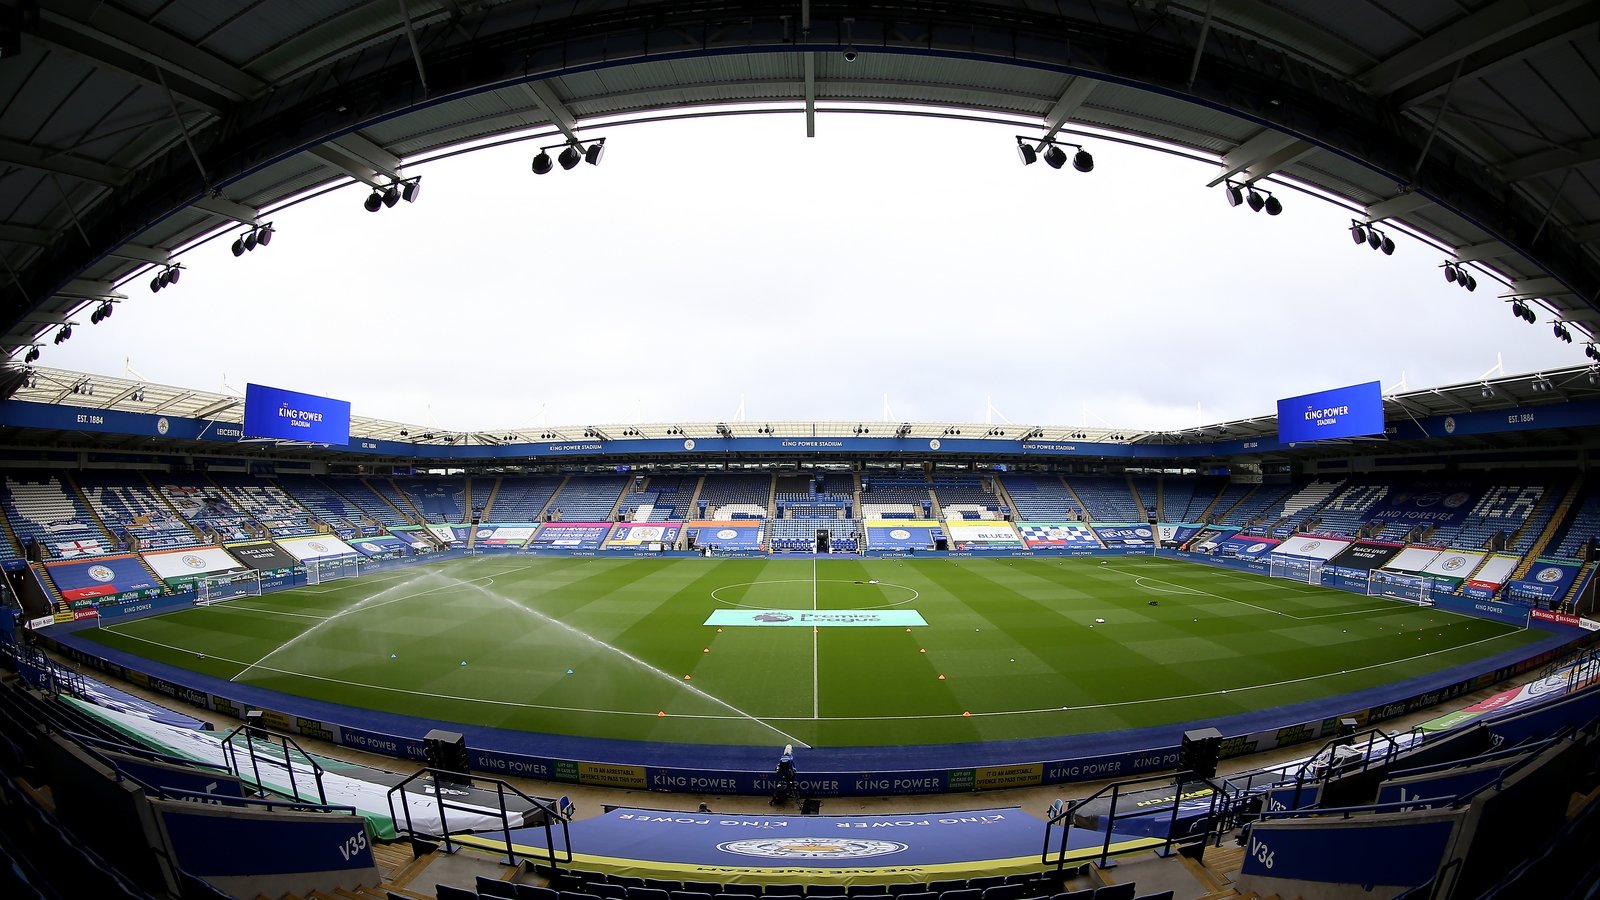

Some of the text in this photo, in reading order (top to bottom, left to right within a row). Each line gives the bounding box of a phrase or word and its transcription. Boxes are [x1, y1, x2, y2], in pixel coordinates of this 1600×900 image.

[77, 414, 104, 424] EST. 1884
[278, 408, 322, 422] KING POWER
[1304, 406, 1348, 420] KING POWER
[1508, 414, 1534, 424] EST. 1884
[291, 420, 310, 428] STADIUM
[1316, 418, 1336, 426] STADIUM
[216, 428, 240, 437] LEICESTER
[1402, 511, 1454, 521] FOREVER
[1101, 530, 1134, 538] NEVER
[1487, 605, 1503, 614] POWER
[158, 680, 206, 704] Chang Chang
[1419, 694, 1439, 708] Chang
[1382, 704, 1405, 718] Chang
[345, 734, 366, 745] KING
[367, 739, 397, 752] POWER
[478, 757, 548, 774] KING POWER
[1133, 756, 1160, 768] KING
[1049, 767, 1079, 778] KING
[1082, 762, 1121, 774] POWER
[653, 775, 687, 786] KING
[691, 777, 736, 788] POWER
[855, 778, 940, 790] KING POWER
[619, 813, 710, 825] POWER
[836, 814, 1005, 828] KING POWER
[340, 830, 366, 861] V35
[1251, 836, 1274, 869] V36
